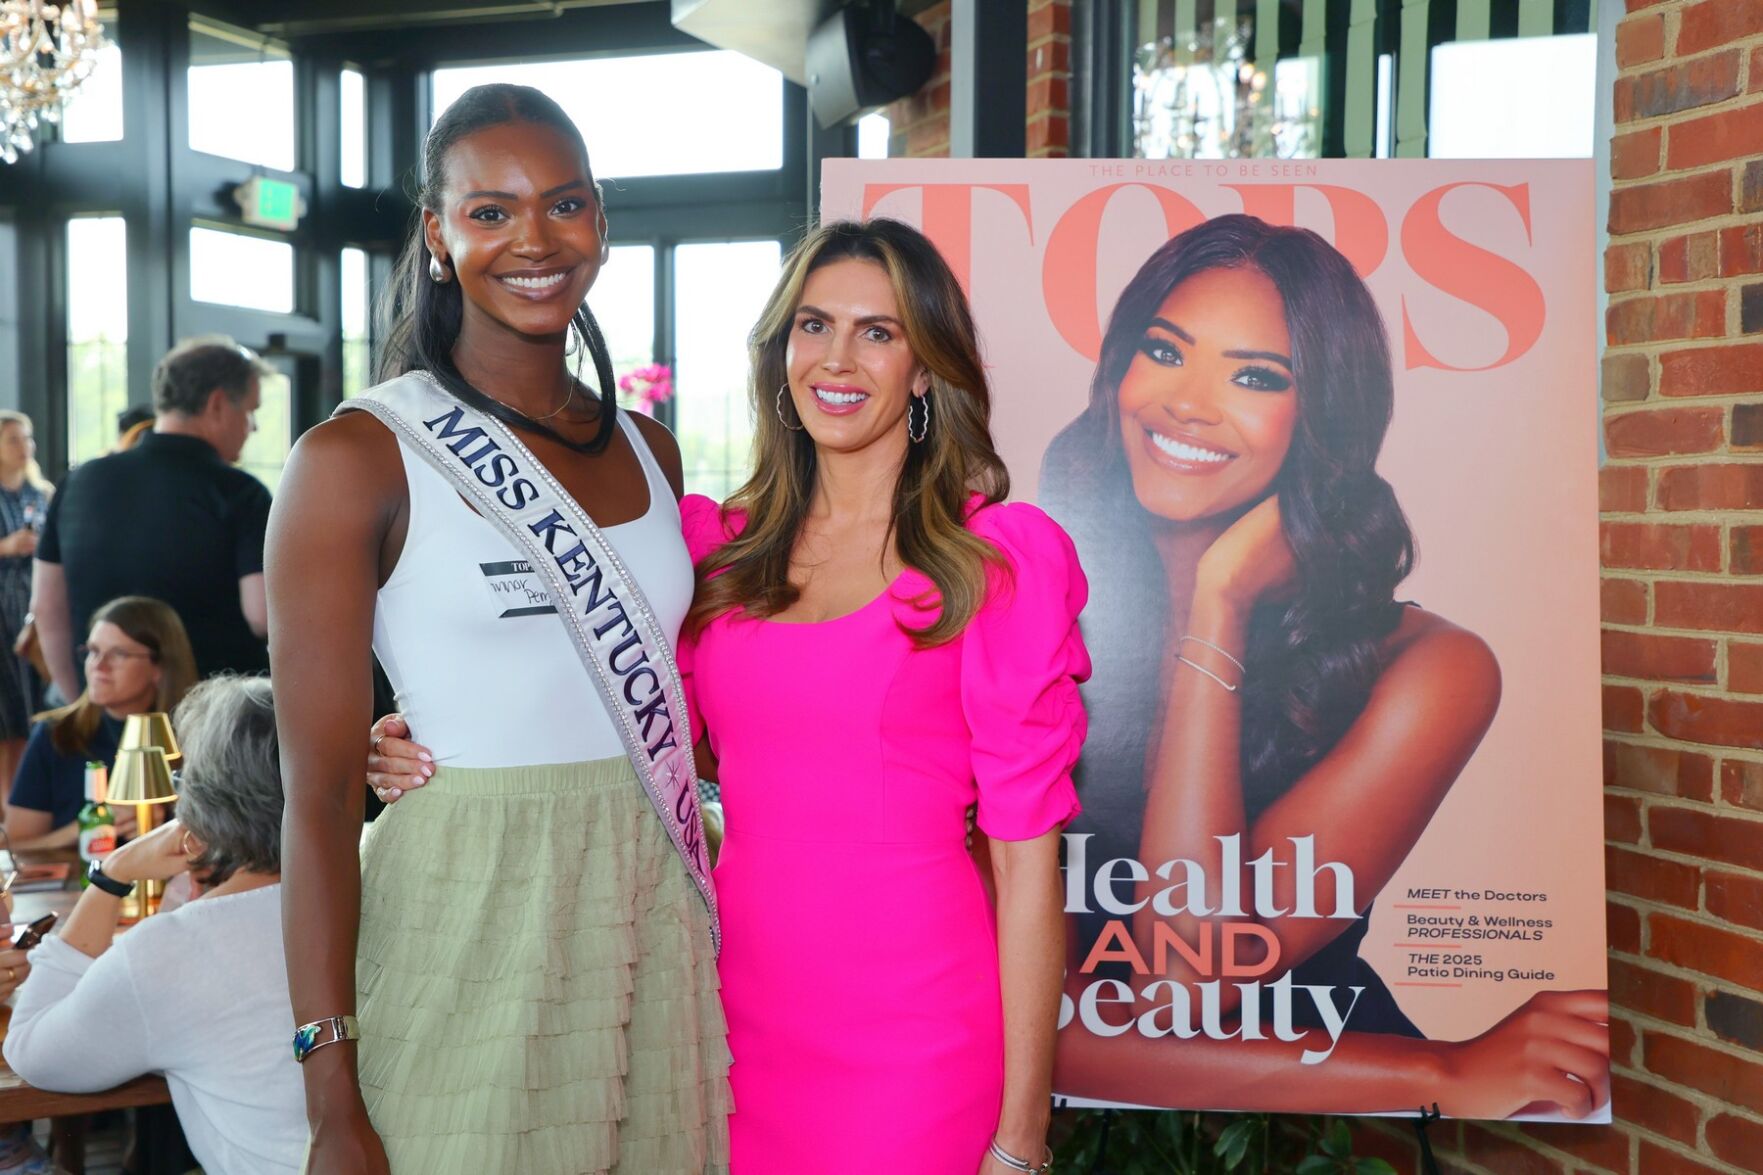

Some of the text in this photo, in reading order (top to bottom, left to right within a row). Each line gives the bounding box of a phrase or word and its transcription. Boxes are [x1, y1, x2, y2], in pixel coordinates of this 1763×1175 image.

[1089, 164, 1318, 177] THE PLACE TO BE SEEN
[511, 562, 530, 572] TOP
[423, 405, 707, 877] MISS KENTUCKY USA
[1407, 888, 1547, 902] MEET the Doctors
[1407, 914, 1553, 928] Beauty & Wellness
[1407, 927, 1543, 941] PROFESSIONALS
[1079, 920, 1282, 978] AND
[1409, 953, 1482, 965] THE 2025
[1407, 966, 1555, 982] Patio Dining Guide
[1057, 969, 1366, 1065] eauty
